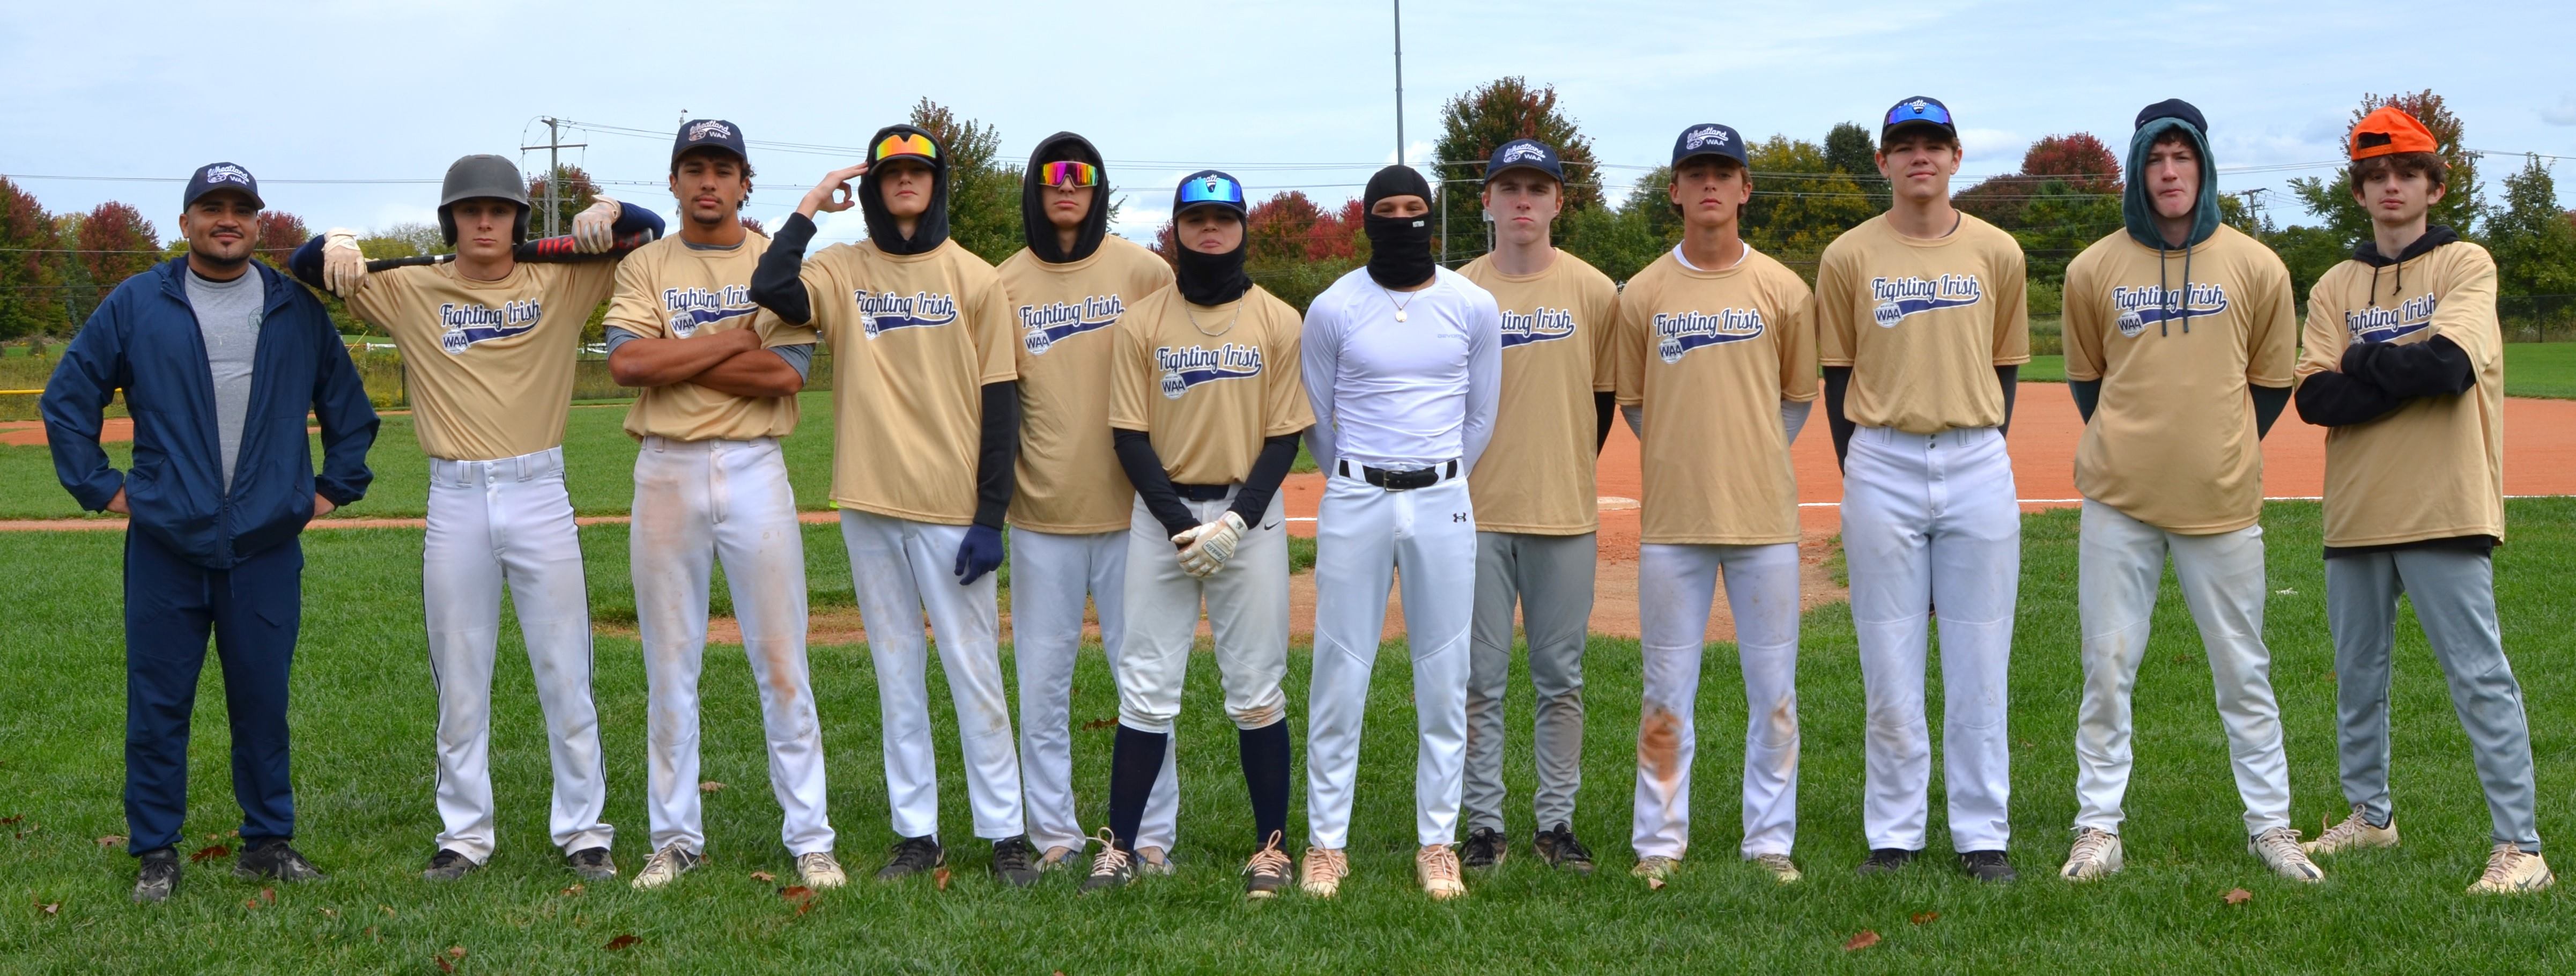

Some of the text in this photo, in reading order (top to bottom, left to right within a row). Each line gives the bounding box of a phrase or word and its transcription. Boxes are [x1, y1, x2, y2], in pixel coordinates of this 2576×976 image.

[690, 120, 729, 135] Wheatland
[709, 131, 728, 139] WAA
[1687, 127, 1727, 143] Wheatland
[1524, 153, 1542, 162] WAA
[208, 165, 248, 178] Wheatland
[230, 175, 247, 186] WAA
[1871, 273, 1979, 304] Fighting Irish
[663, 285, 751, 315] Fighting Iris
[854, 290, 954, 320] Fighting Irish
[440, 298, 541, 331] Fighting Irish
[1018, 294, 1123, 329] Fighting Irish
[1875, 308, 1901, 321] WAA
[671, 318, 695, 331] WAA
[1535, 307, 1572, 330] Irish
[1654, 308, 1760, 338] Fighting Irish
[2118, 318, 2142, 331] WAA
[443, 336, 468, 347] WAA
[1025, 336, 1049, 349] WAA
[1156, 343, 1261, 373] Fighting Irish
[1659, 345, 1683, 358] WAA
[1161, 380, 1186, 393] WAA
